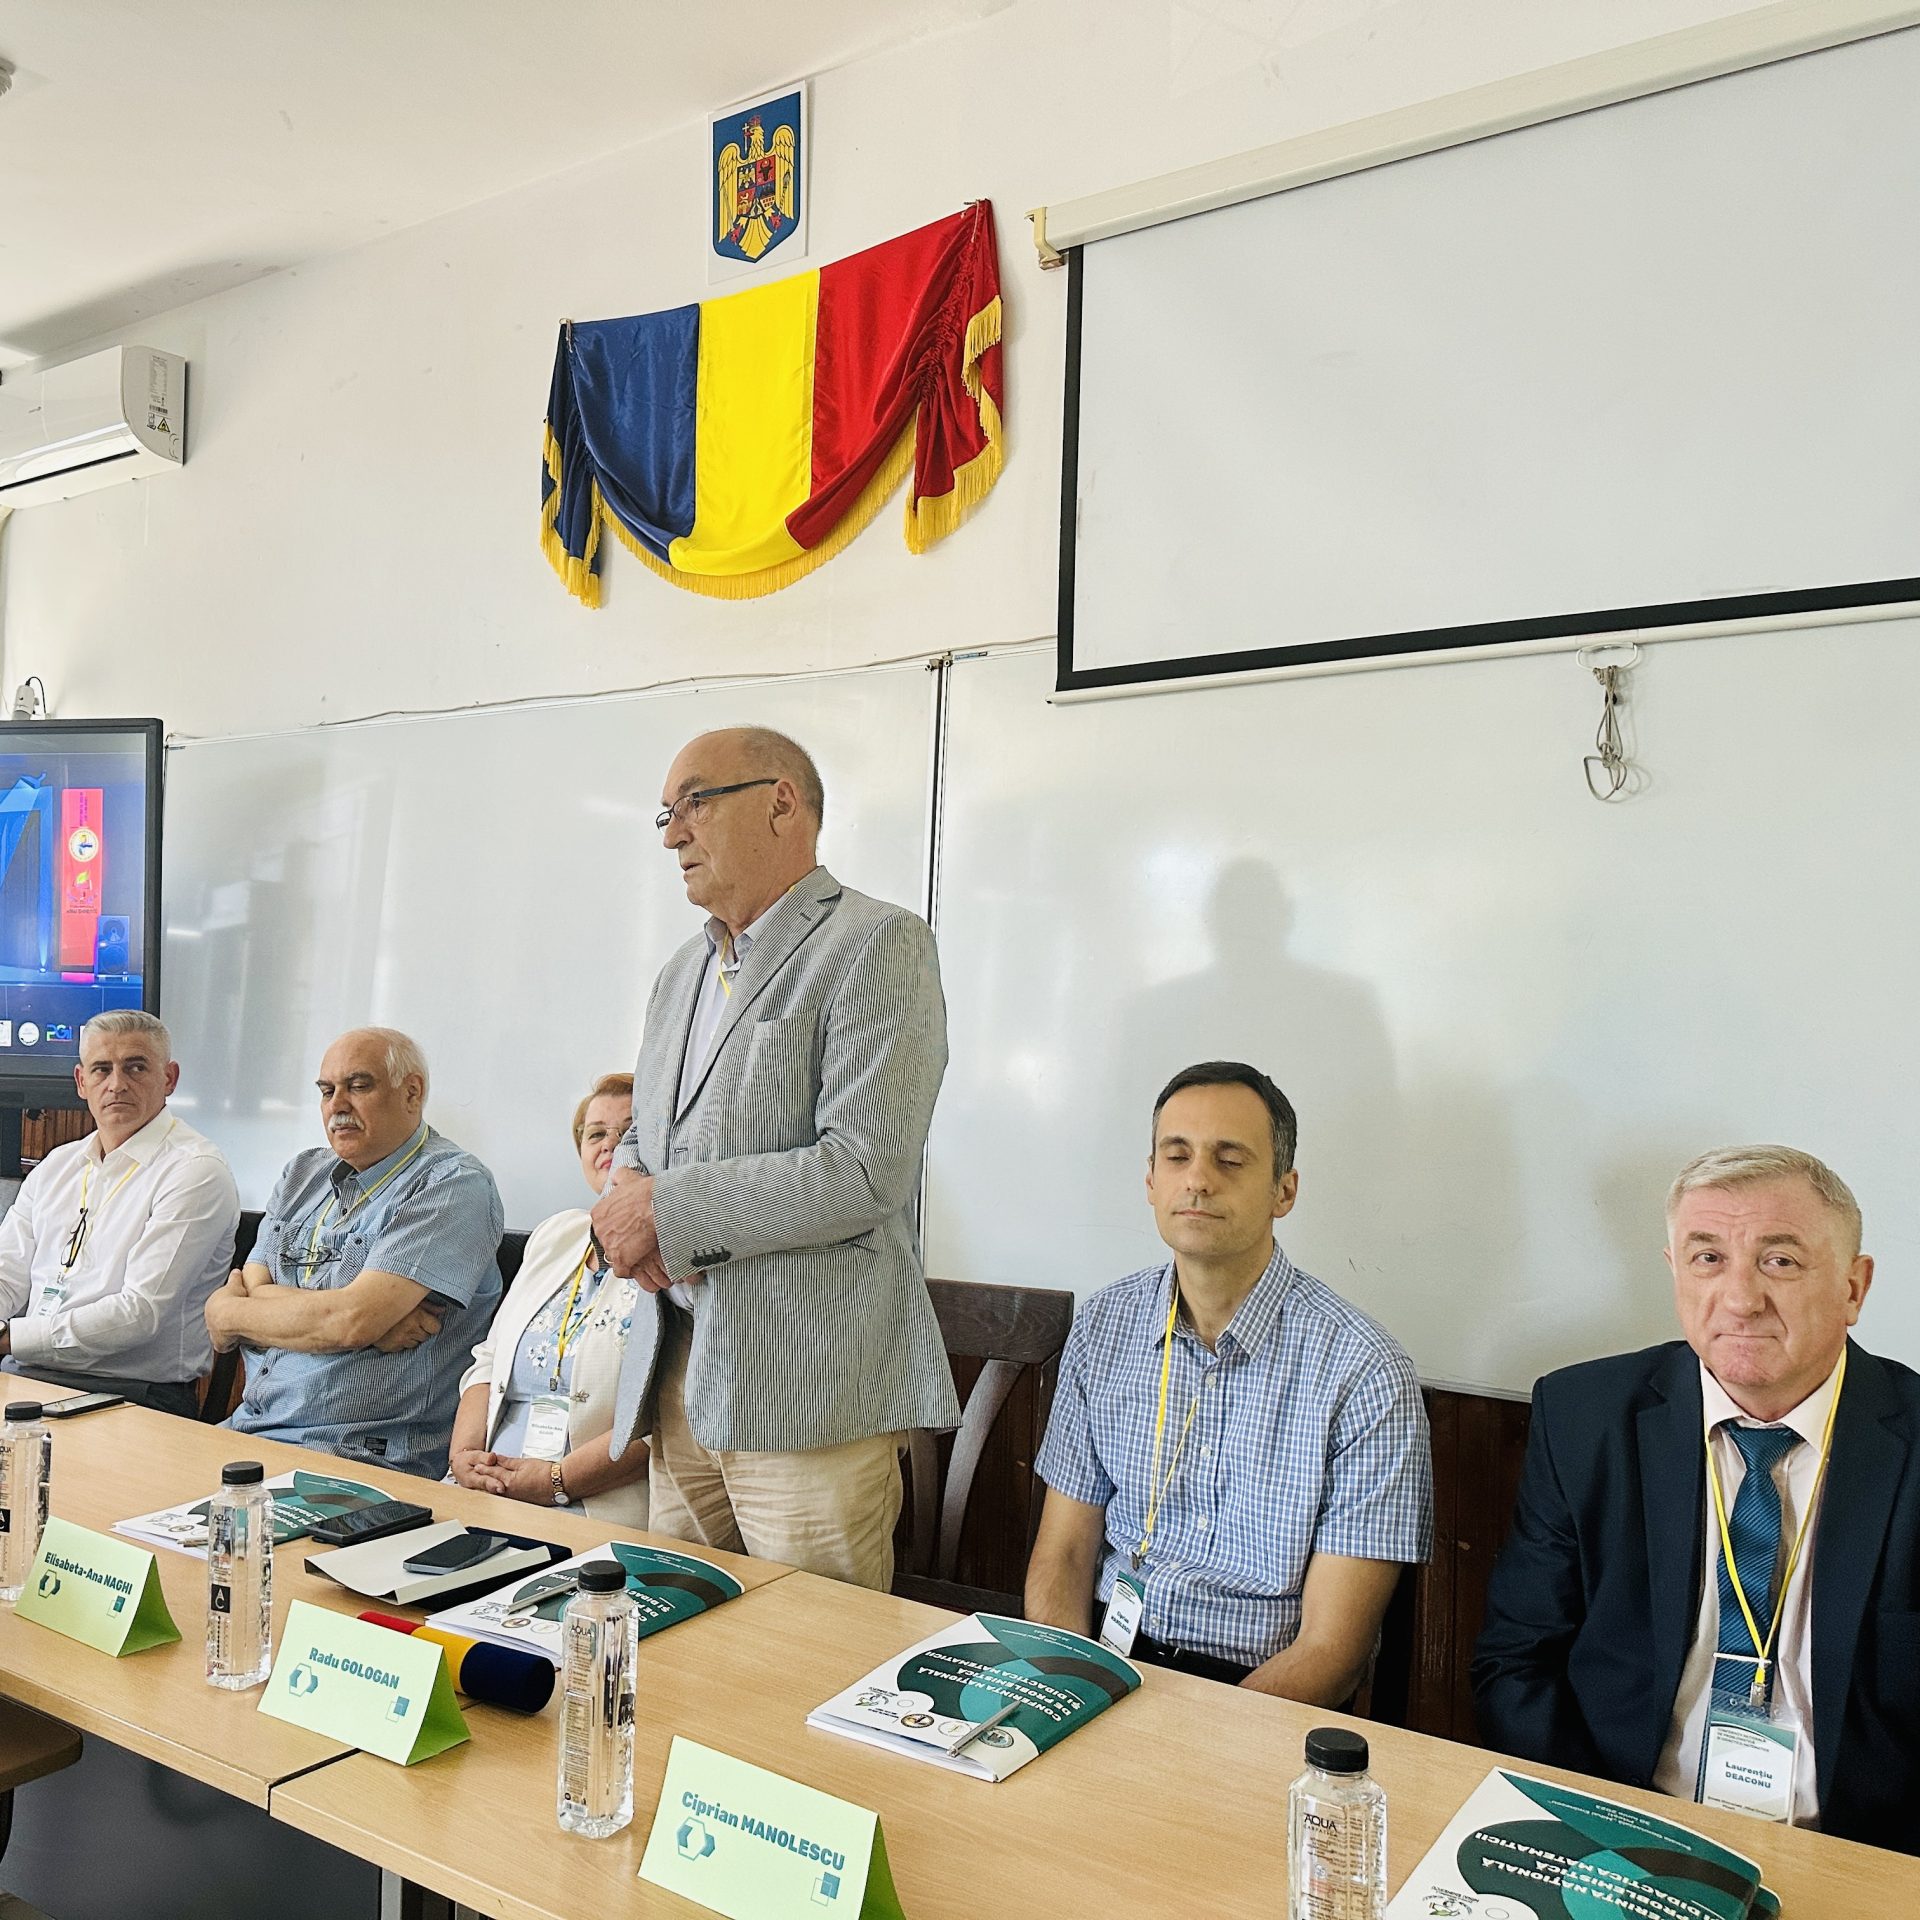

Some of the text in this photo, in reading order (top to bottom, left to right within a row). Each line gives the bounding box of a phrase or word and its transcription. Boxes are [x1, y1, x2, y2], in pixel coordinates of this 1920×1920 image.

[44, 1551, 133, 1596] Elisabeta-Ana NAGHI
[309, 1647, 400, 1690] Radu GOLOGAN
[1002, 1671, 1067, 1700] DIDACTICA
[1053, 1702, 1072, 1717] DE
[1725, 1761, 1773, 1779] Laurențiu
[1725, 1771, 1771, 1789] DEACONU
[682, 1791, 845, 1870] Ciprian MANOLESCU
[1303, 1813, 1338, 1832] AQUA
[1475, 1832, 1701, 1917] DIDACTICA MATEMATICII
